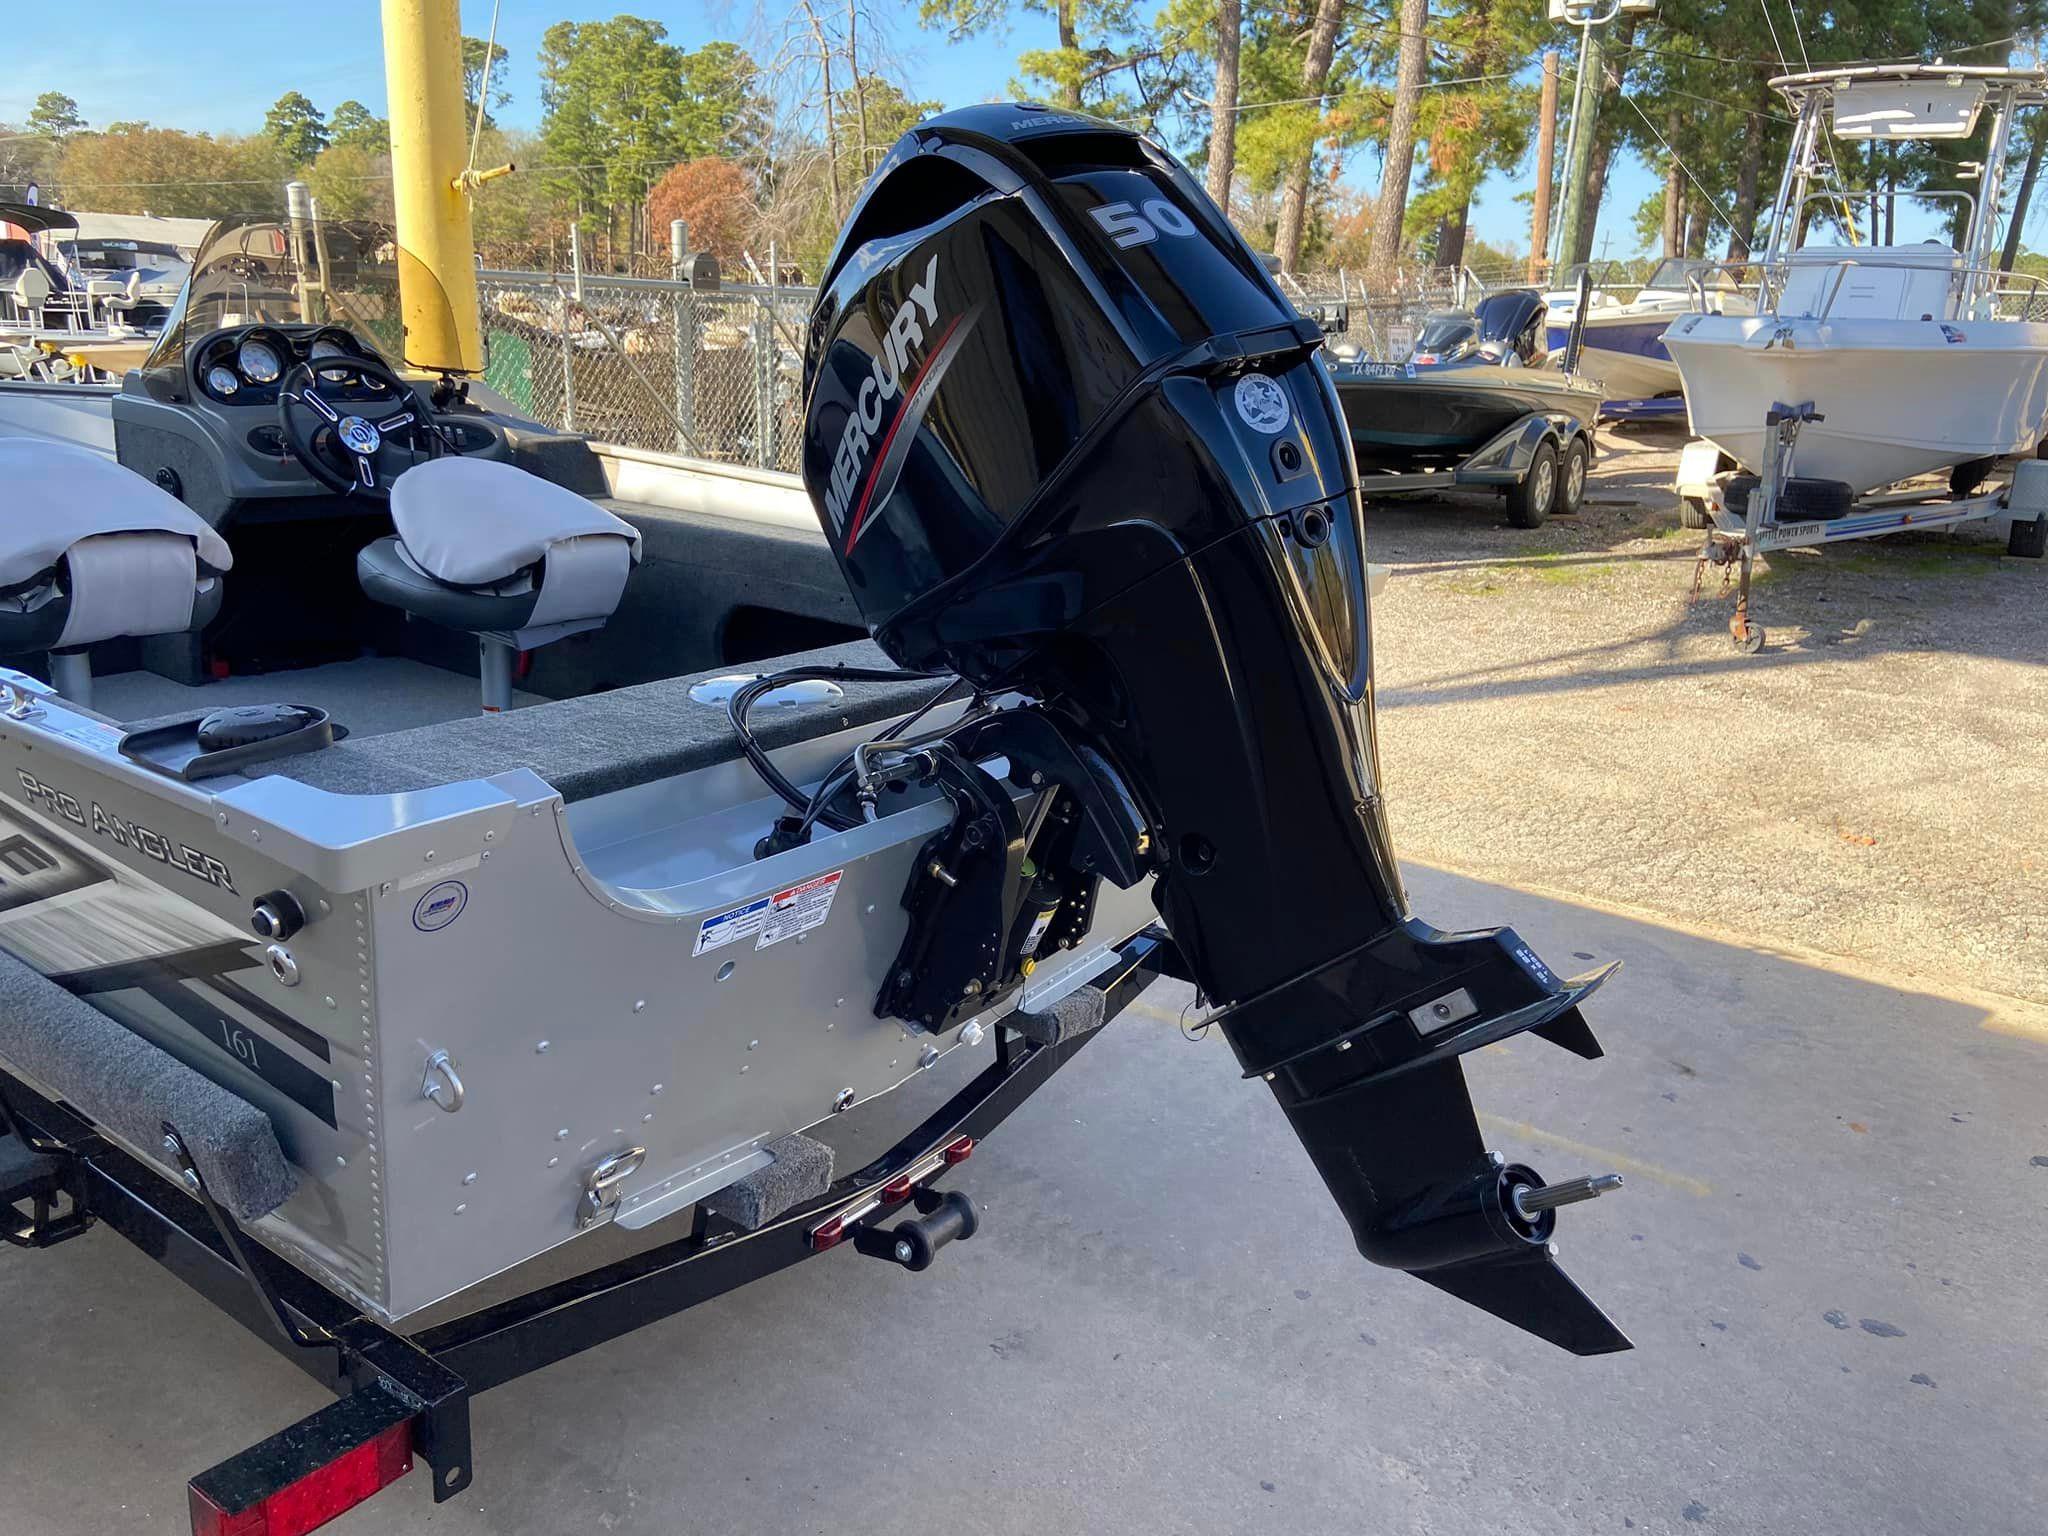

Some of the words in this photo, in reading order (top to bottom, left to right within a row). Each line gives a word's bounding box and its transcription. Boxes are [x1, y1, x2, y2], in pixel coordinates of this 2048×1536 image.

[1010, 113, 1089, 131] MERCU
[1087, 199, 1199, 250] 50
[825, 254, 939, 538] MERCURY
[1778, 527, 1799, 538] POWER
[1799, 524, 1820, 536] SPORTS
[16, 768, 87, 827] PRO
[92, 801, 240, 896] ANGLER
[798, 878, 826, 894] DANGER
[723, 907, 751, 921] NOTICE
[219, 1019, 262, 1070] 161
